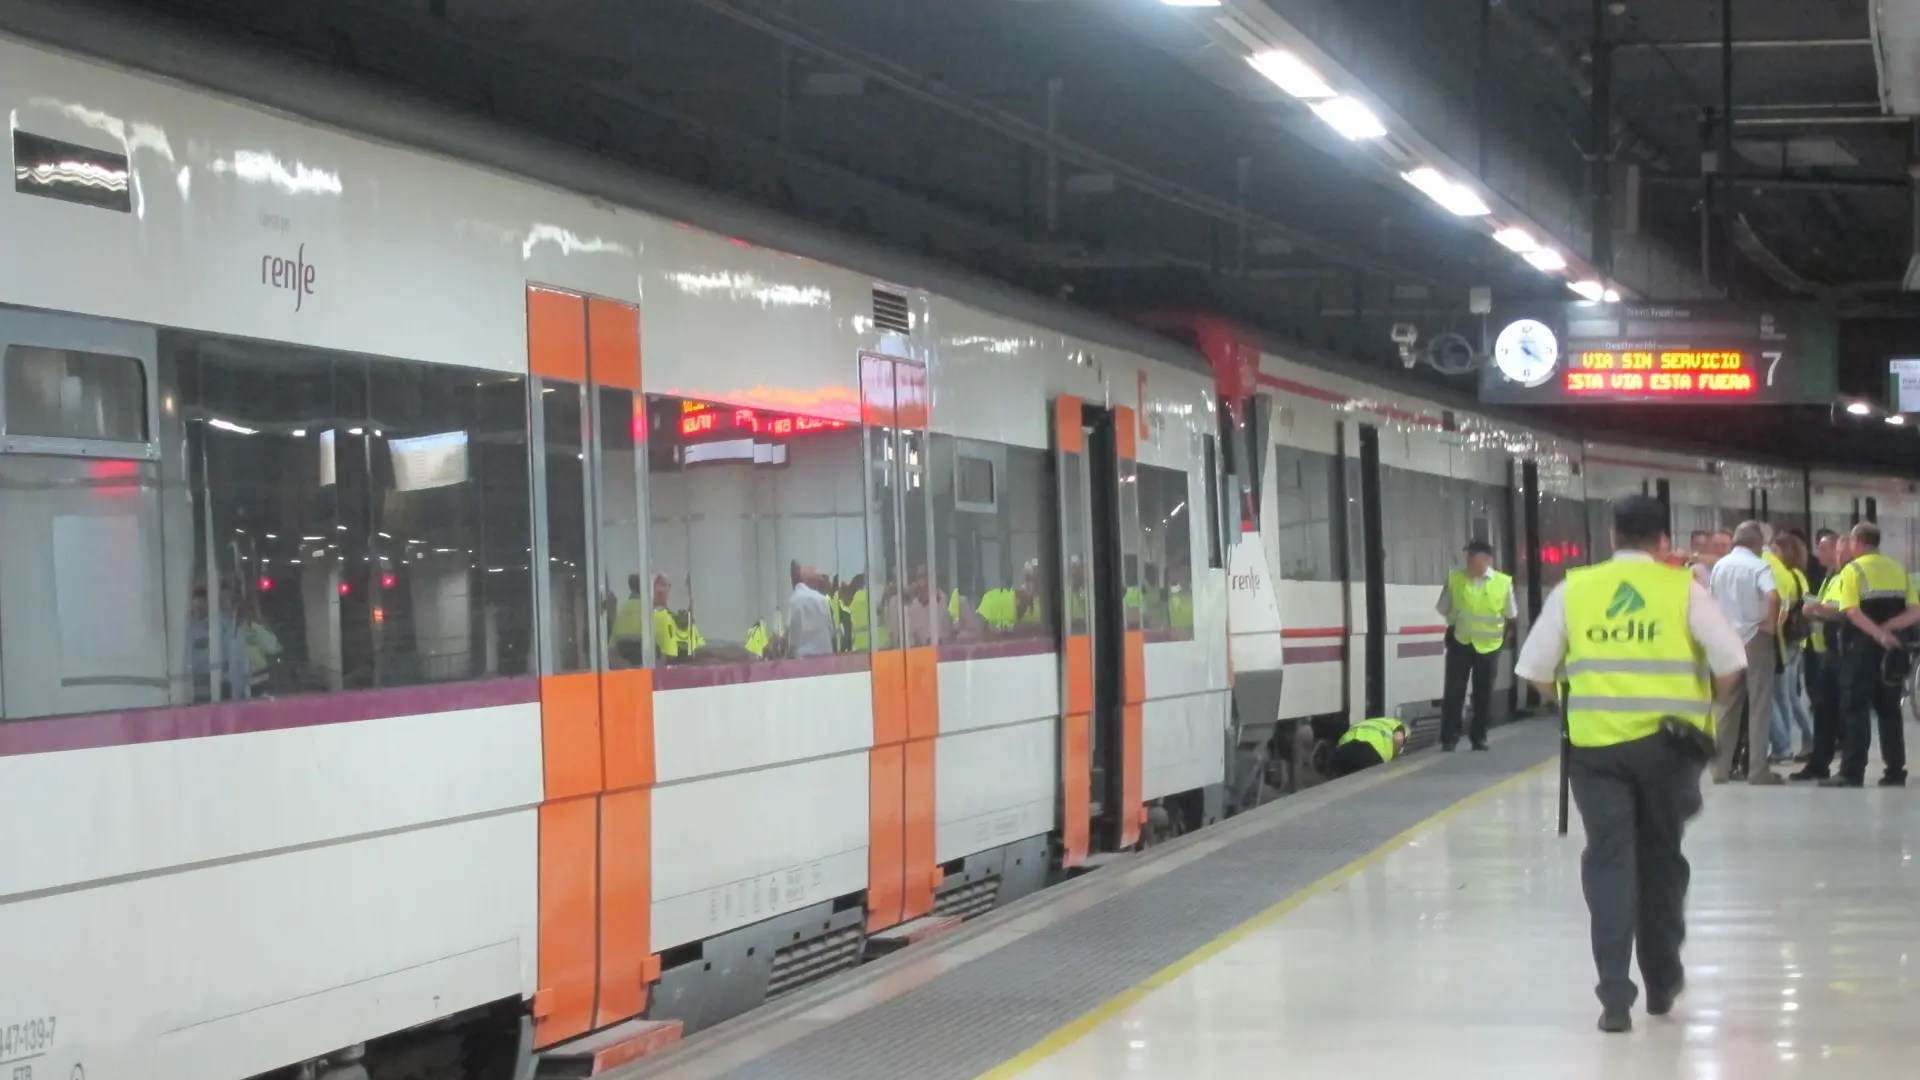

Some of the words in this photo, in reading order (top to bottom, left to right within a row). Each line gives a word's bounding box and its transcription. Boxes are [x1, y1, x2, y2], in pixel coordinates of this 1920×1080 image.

[262, 242, 315, 312] renfe
[1582, 352, 1613, 369] VIA
[1622, 352, 1653, 369] SIN
[1660, 352, 1741, 369] SERVICIO
[1761, 351, 1782, 387] 7
[1611, 373, 1643, 390] VIA
[1650, 373, 1692, 390] ESTA
[1698, 373, 1751, 390] FUERA
[1232, 565, 1261, 600] renfe
[1586, 619, 1661, 643] adif
